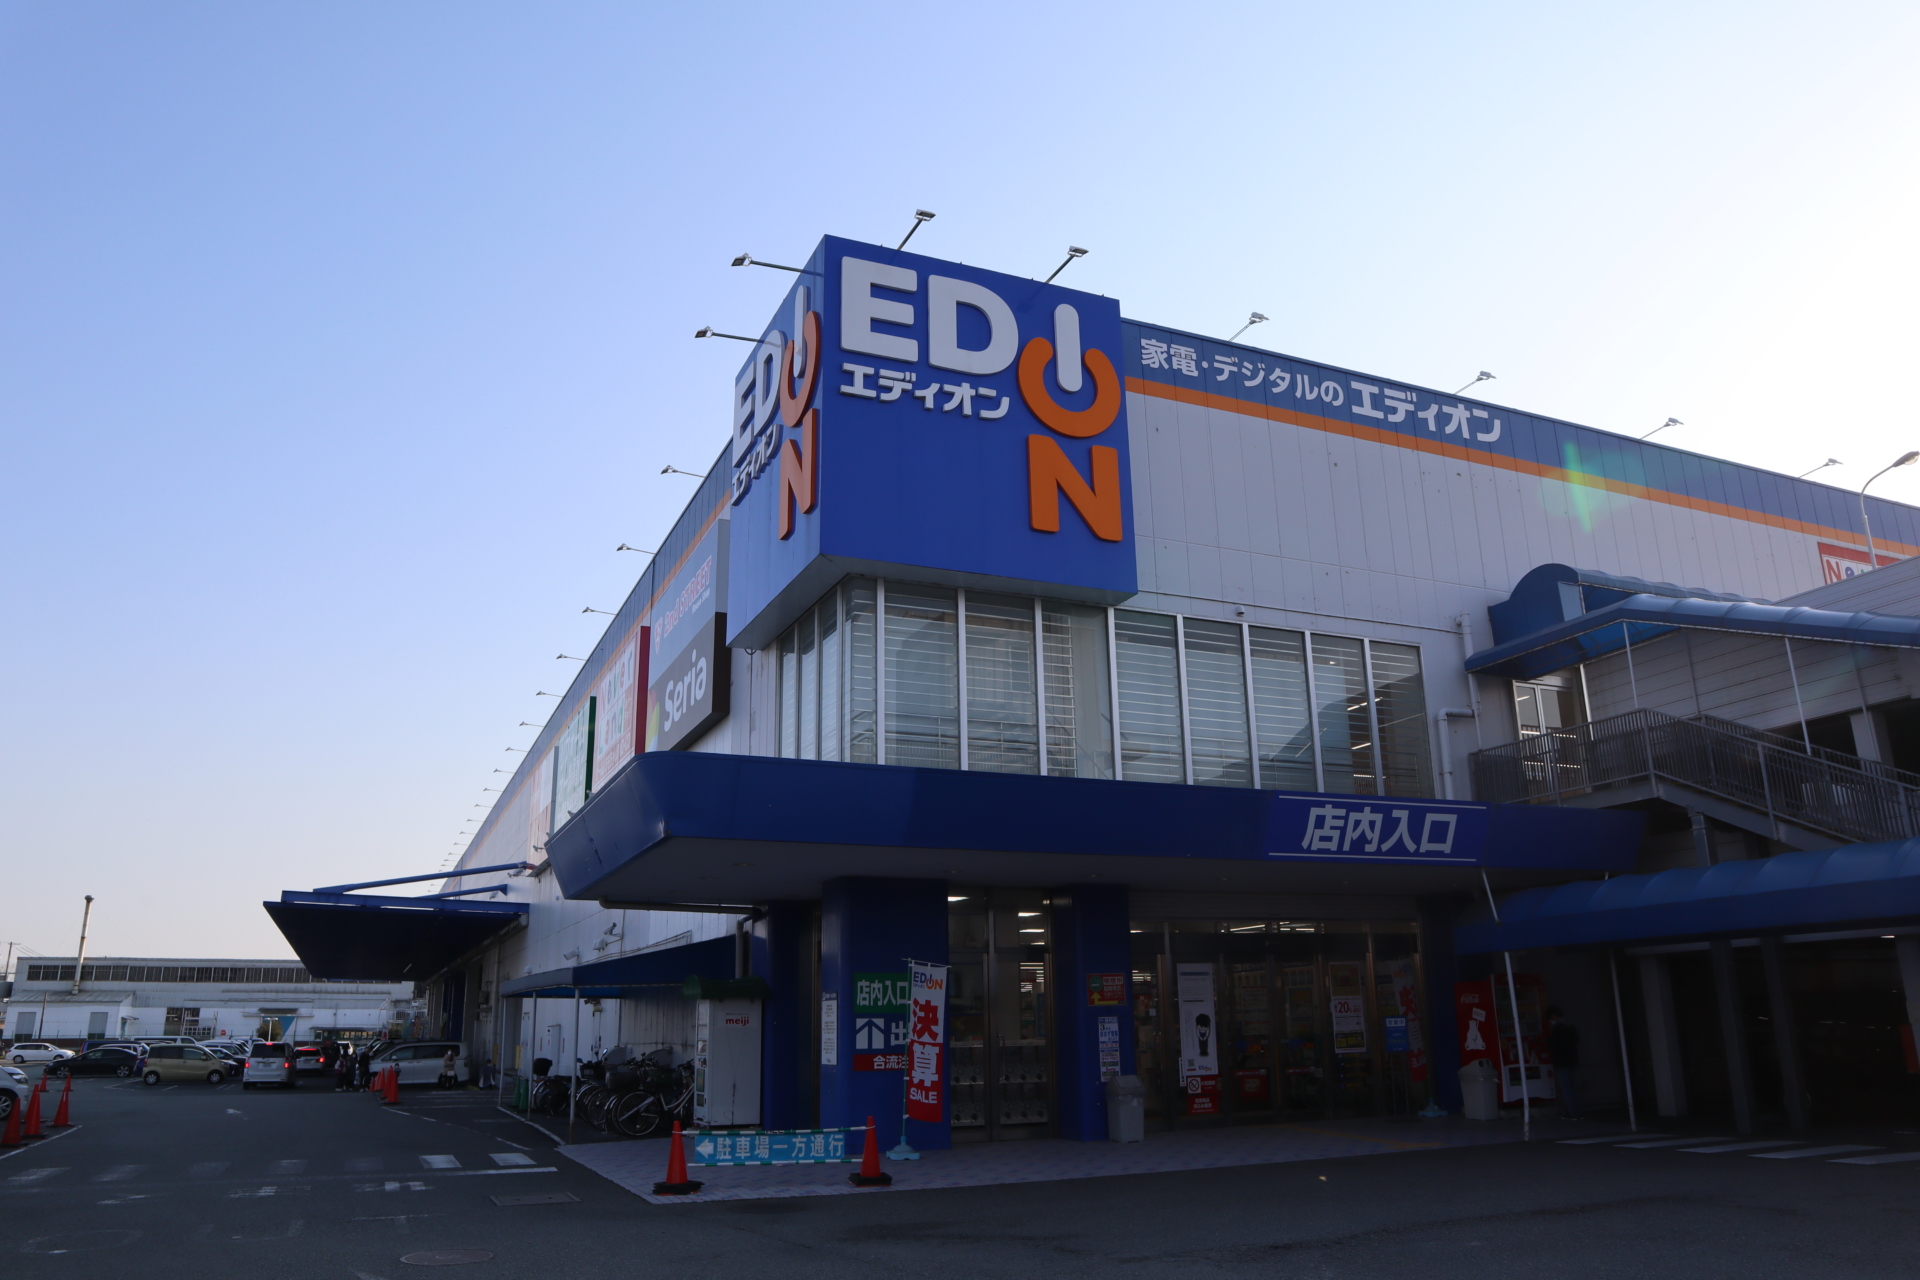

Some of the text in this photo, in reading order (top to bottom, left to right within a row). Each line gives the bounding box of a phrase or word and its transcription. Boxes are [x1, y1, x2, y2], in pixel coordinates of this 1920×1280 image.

[840, 362, 1010, 419] エディオン
[731, 422, 786, 507] エディオン
[679, 555, 712, 618] STREET
[599, 648, 633, 715] Never
[664, 649, 707, 732] Seria
[598, 695, 625, 756] Land
[1301, 804, 1458, 854] 店内入口
[856, 979, 909, 1006] 店内入口
[913, 971, 943, 990] EDION
[725, 1016, 749, 1027] meiji
[911, 997, 940, 1087] 決算
[909, 1087, 939, 1105] SALE
[716, 1134, 844, 1160] 駐車場一方通行
